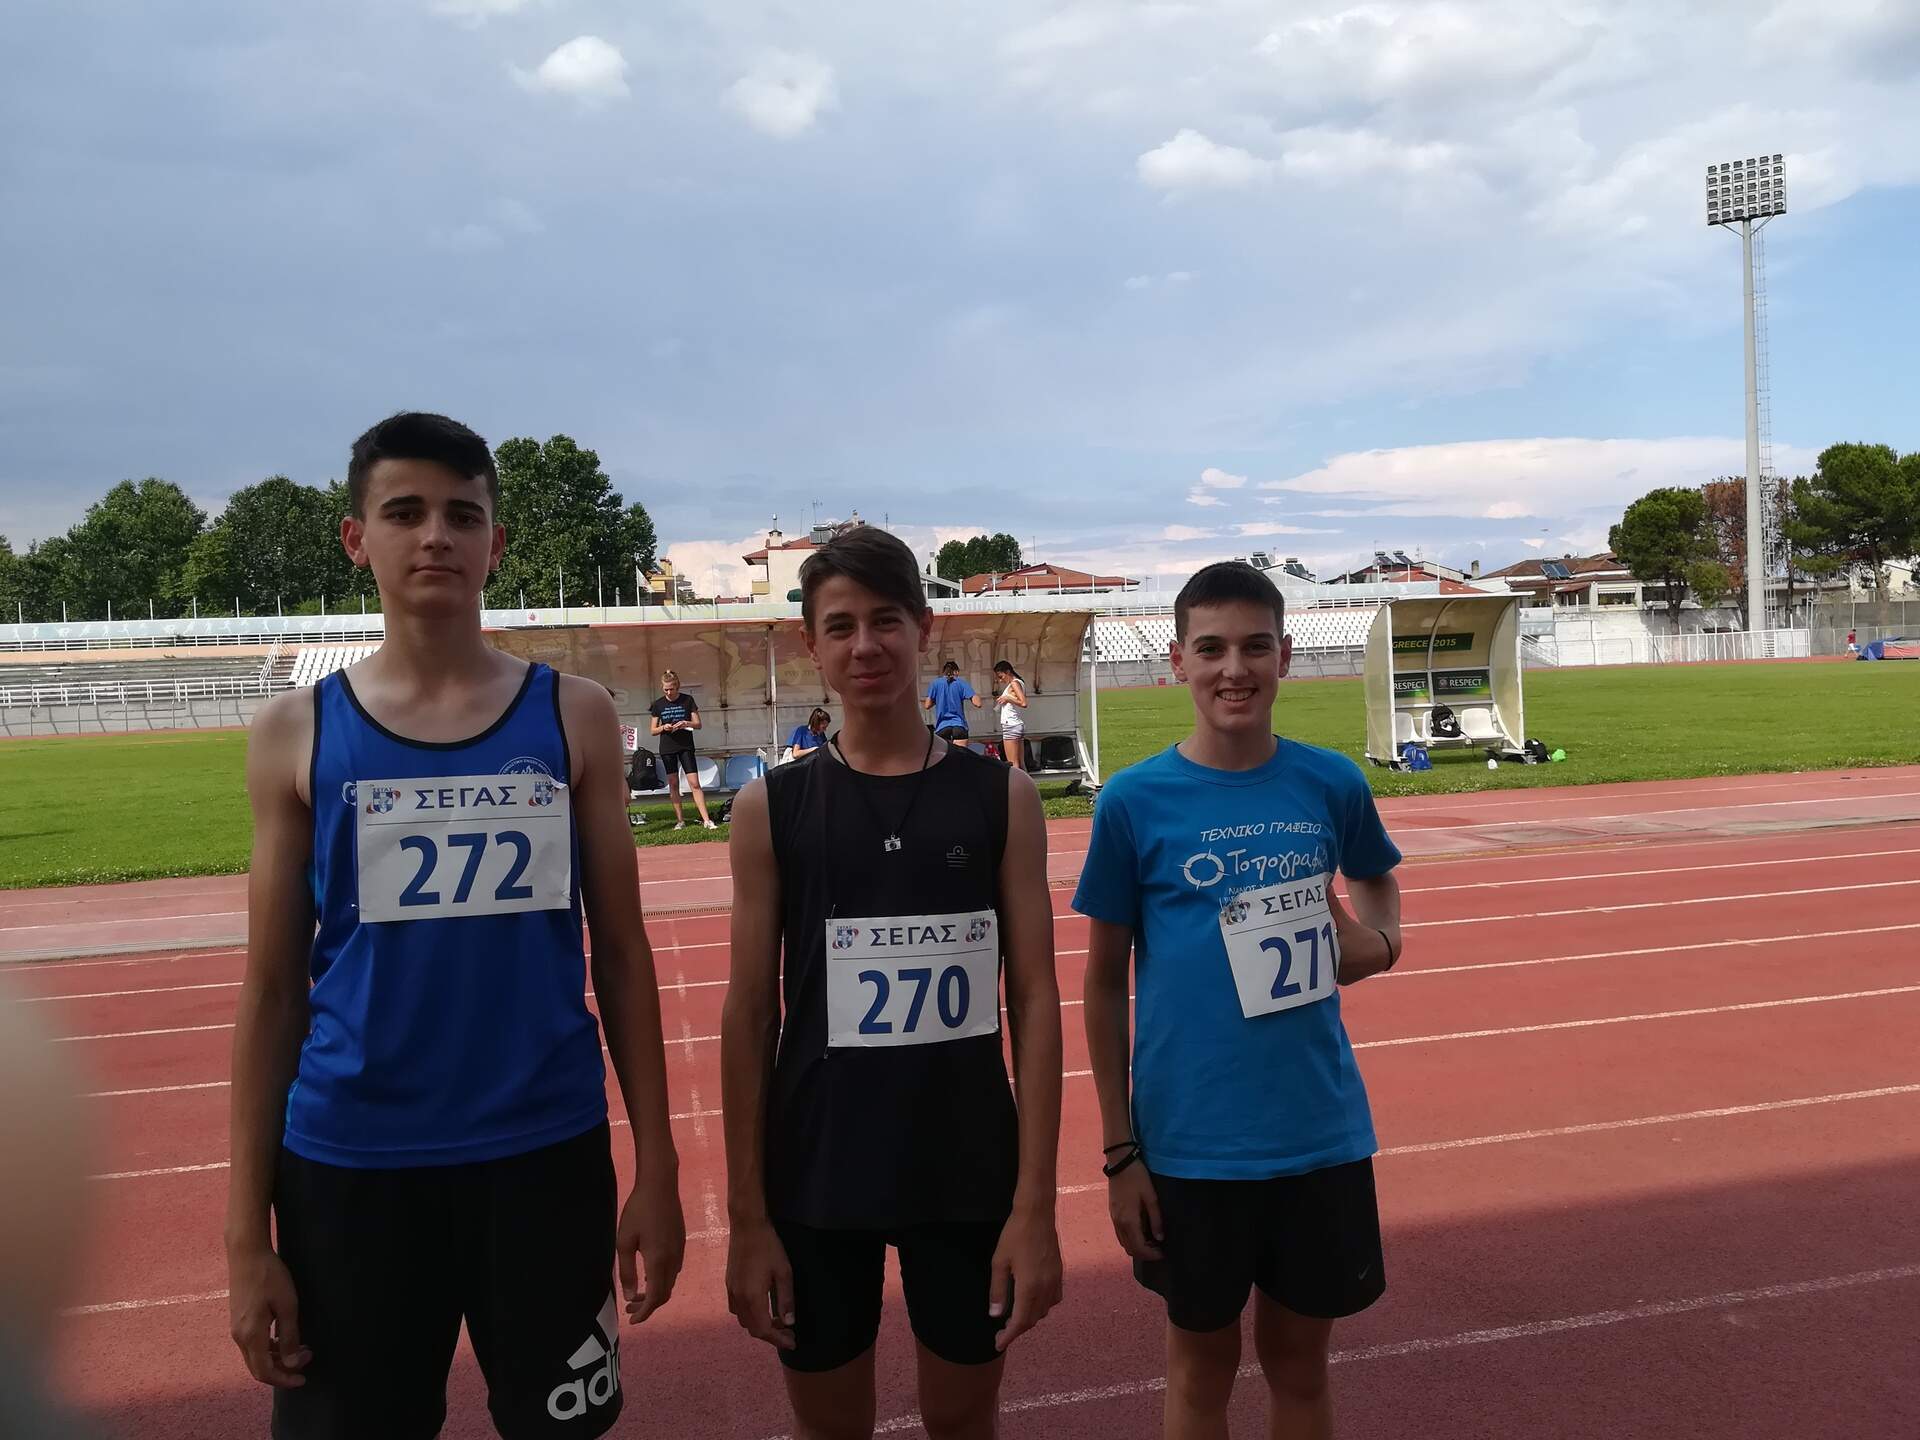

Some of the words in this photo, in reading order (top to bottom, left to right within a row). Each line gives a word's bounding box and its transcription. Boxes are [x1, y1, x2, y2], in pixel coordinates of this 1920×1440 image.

[1392, 639, 1429, 649] GREECE
[1433, 638, 1457, 648] 2015
[1393, 681, 1426, 690] RESPECT
[1449, 678, 1482, 687] RESPECT
[414, 786, 518, 810] ΣΕΓΑΣ
[1200, 823, 1265, 843] ΤΕΧΝΙΚΟ
[1269, 822, 1322, 834] ΓΡΑΦΕΙΟ
[399, 831, 533, 907] 272
[1261, 885, 1325, 915] ΣΕΓΑΣ
[870, 924, 957, 946] ΣΕΓΑΣ
[1259, 921, 1338, 1000] 271
[858, 965, 970, 1035] 270
